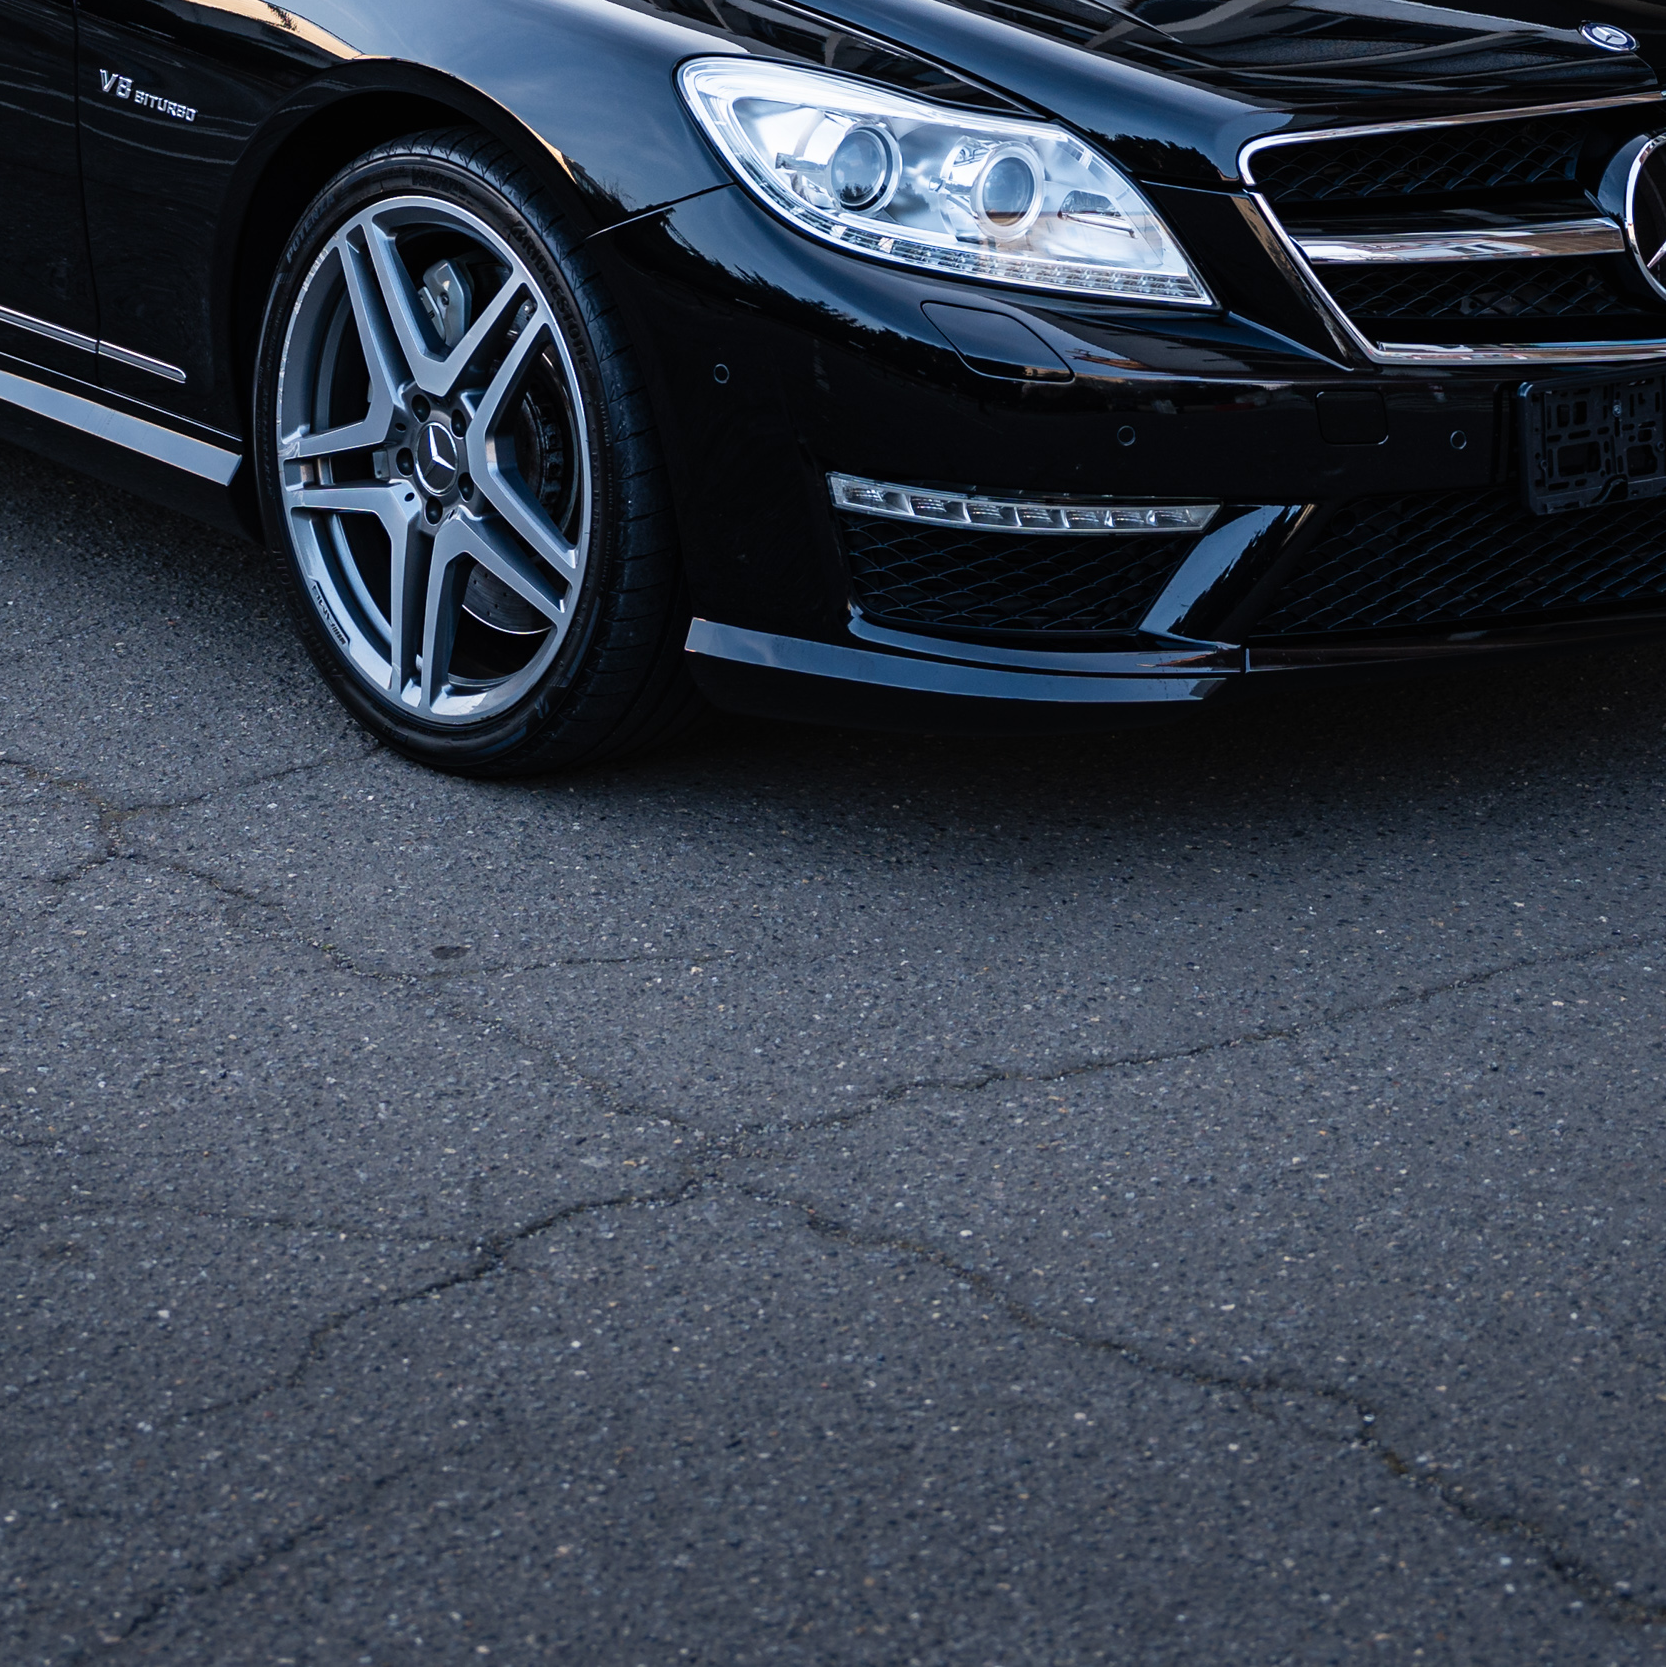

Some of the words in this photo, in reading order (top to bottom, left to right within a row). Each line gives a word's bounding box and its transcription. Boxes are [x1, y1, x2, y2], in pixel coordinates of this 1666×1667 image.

[99, 68, 135, 100] V8
[134, 89, 199, 123] BITURBO
[285, 192, 336, 265] POTENZA
[510, 220, 591, 372] BRIDGESTONE
